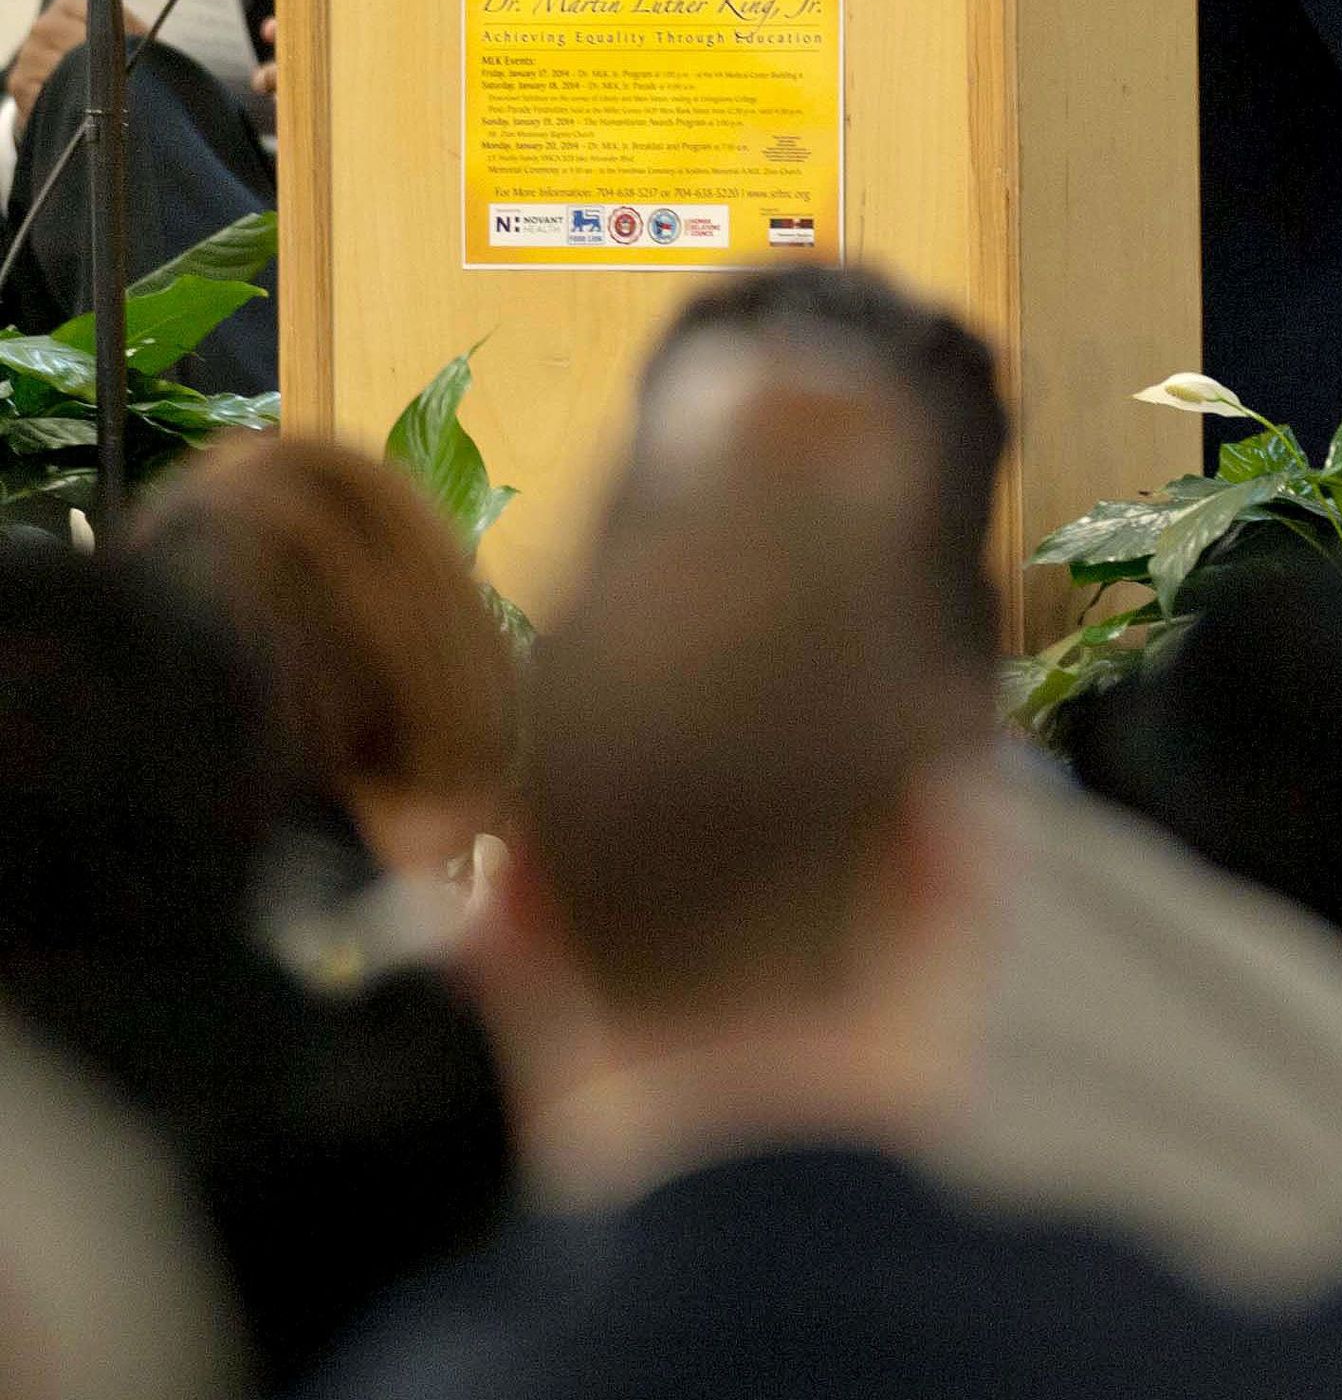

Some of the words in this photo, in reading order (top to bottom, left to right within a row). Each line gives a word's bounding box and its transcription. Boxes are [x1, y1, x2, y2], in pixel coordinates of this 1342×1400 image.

[483, 31, 566, 47] Achieving
[575, 31, 646, 47] Equality
[734, 31, 823, 44] Education
